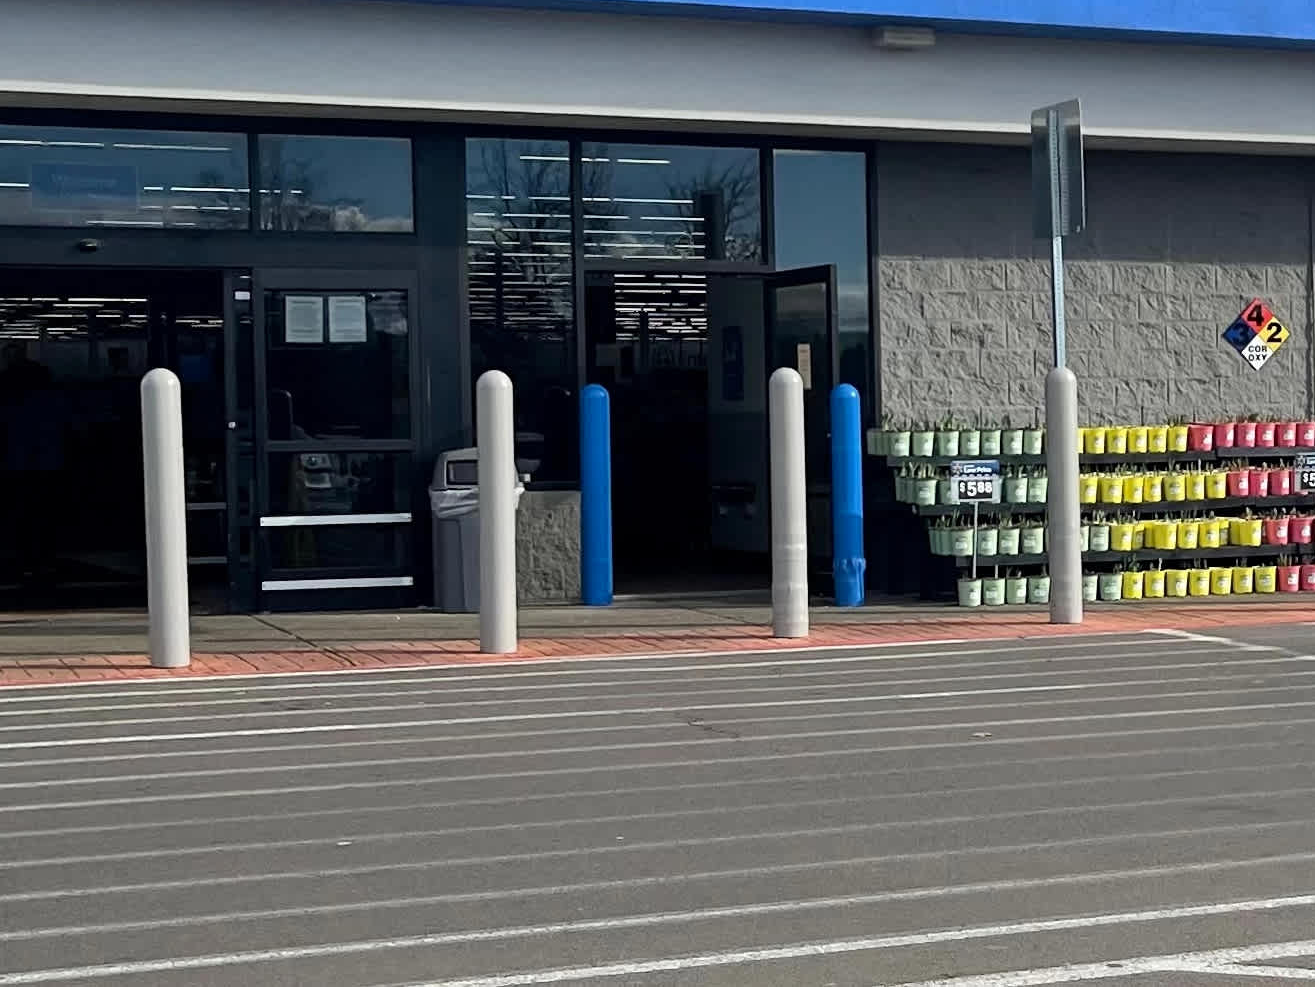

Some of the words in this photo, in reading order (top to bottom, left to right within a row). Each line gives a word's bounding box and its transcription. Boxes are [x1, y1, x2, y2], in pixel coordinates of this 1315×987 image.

[1247, 304, 1264, 327] 4
[1267, 322, 1282, 343] 2
[1248, 354, 1267, 362] OXY
